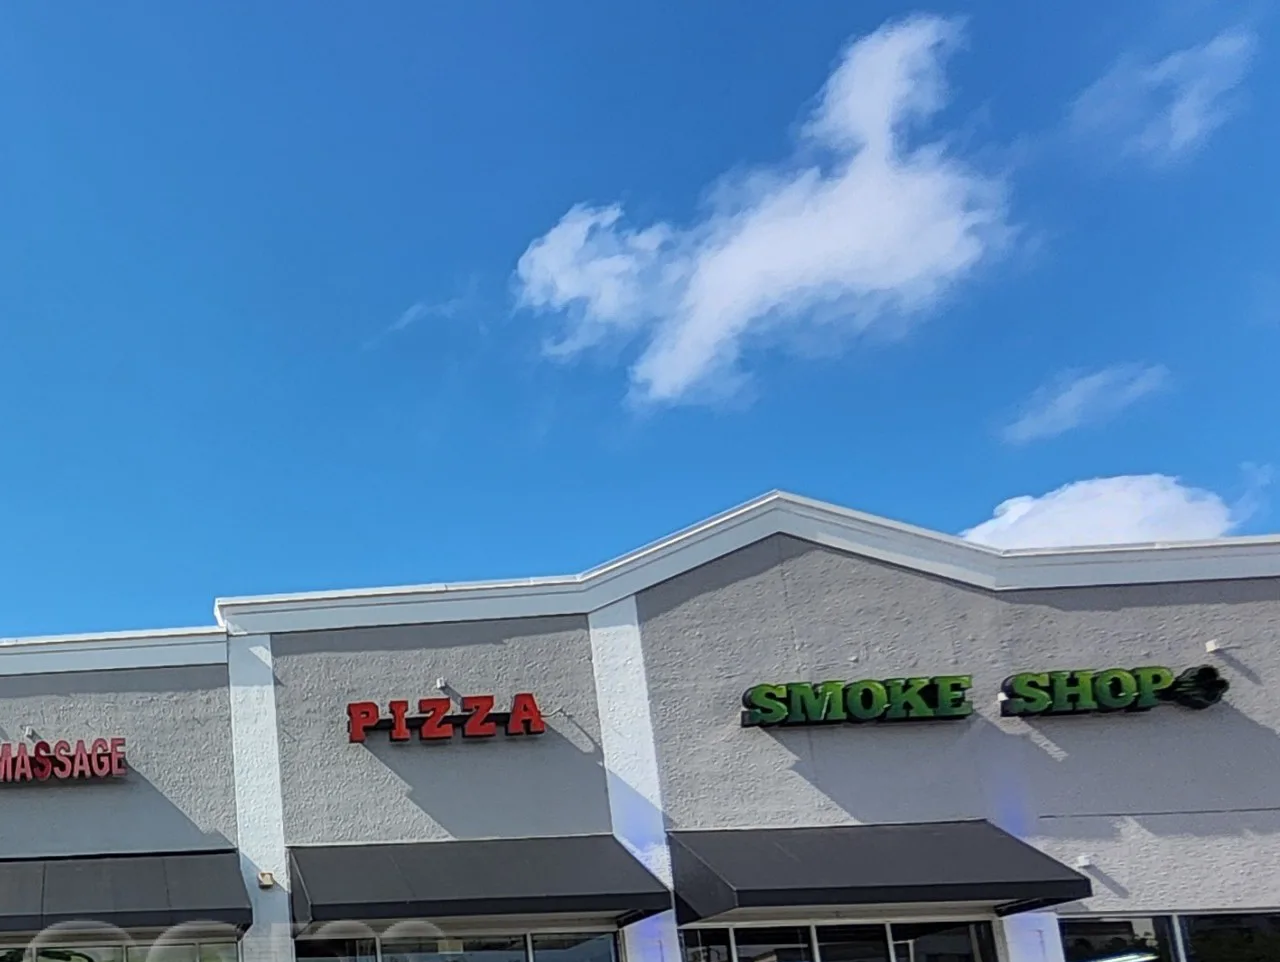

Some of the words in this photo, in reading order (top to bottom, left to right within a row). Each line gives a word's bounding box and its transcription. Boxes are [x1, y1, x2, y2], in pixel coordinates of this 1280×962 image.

[347, 692, 546, 743] PIZZA
[742, 675, 973, 727] SMOKE
[1000, 666, 1174, 717] SHOP
